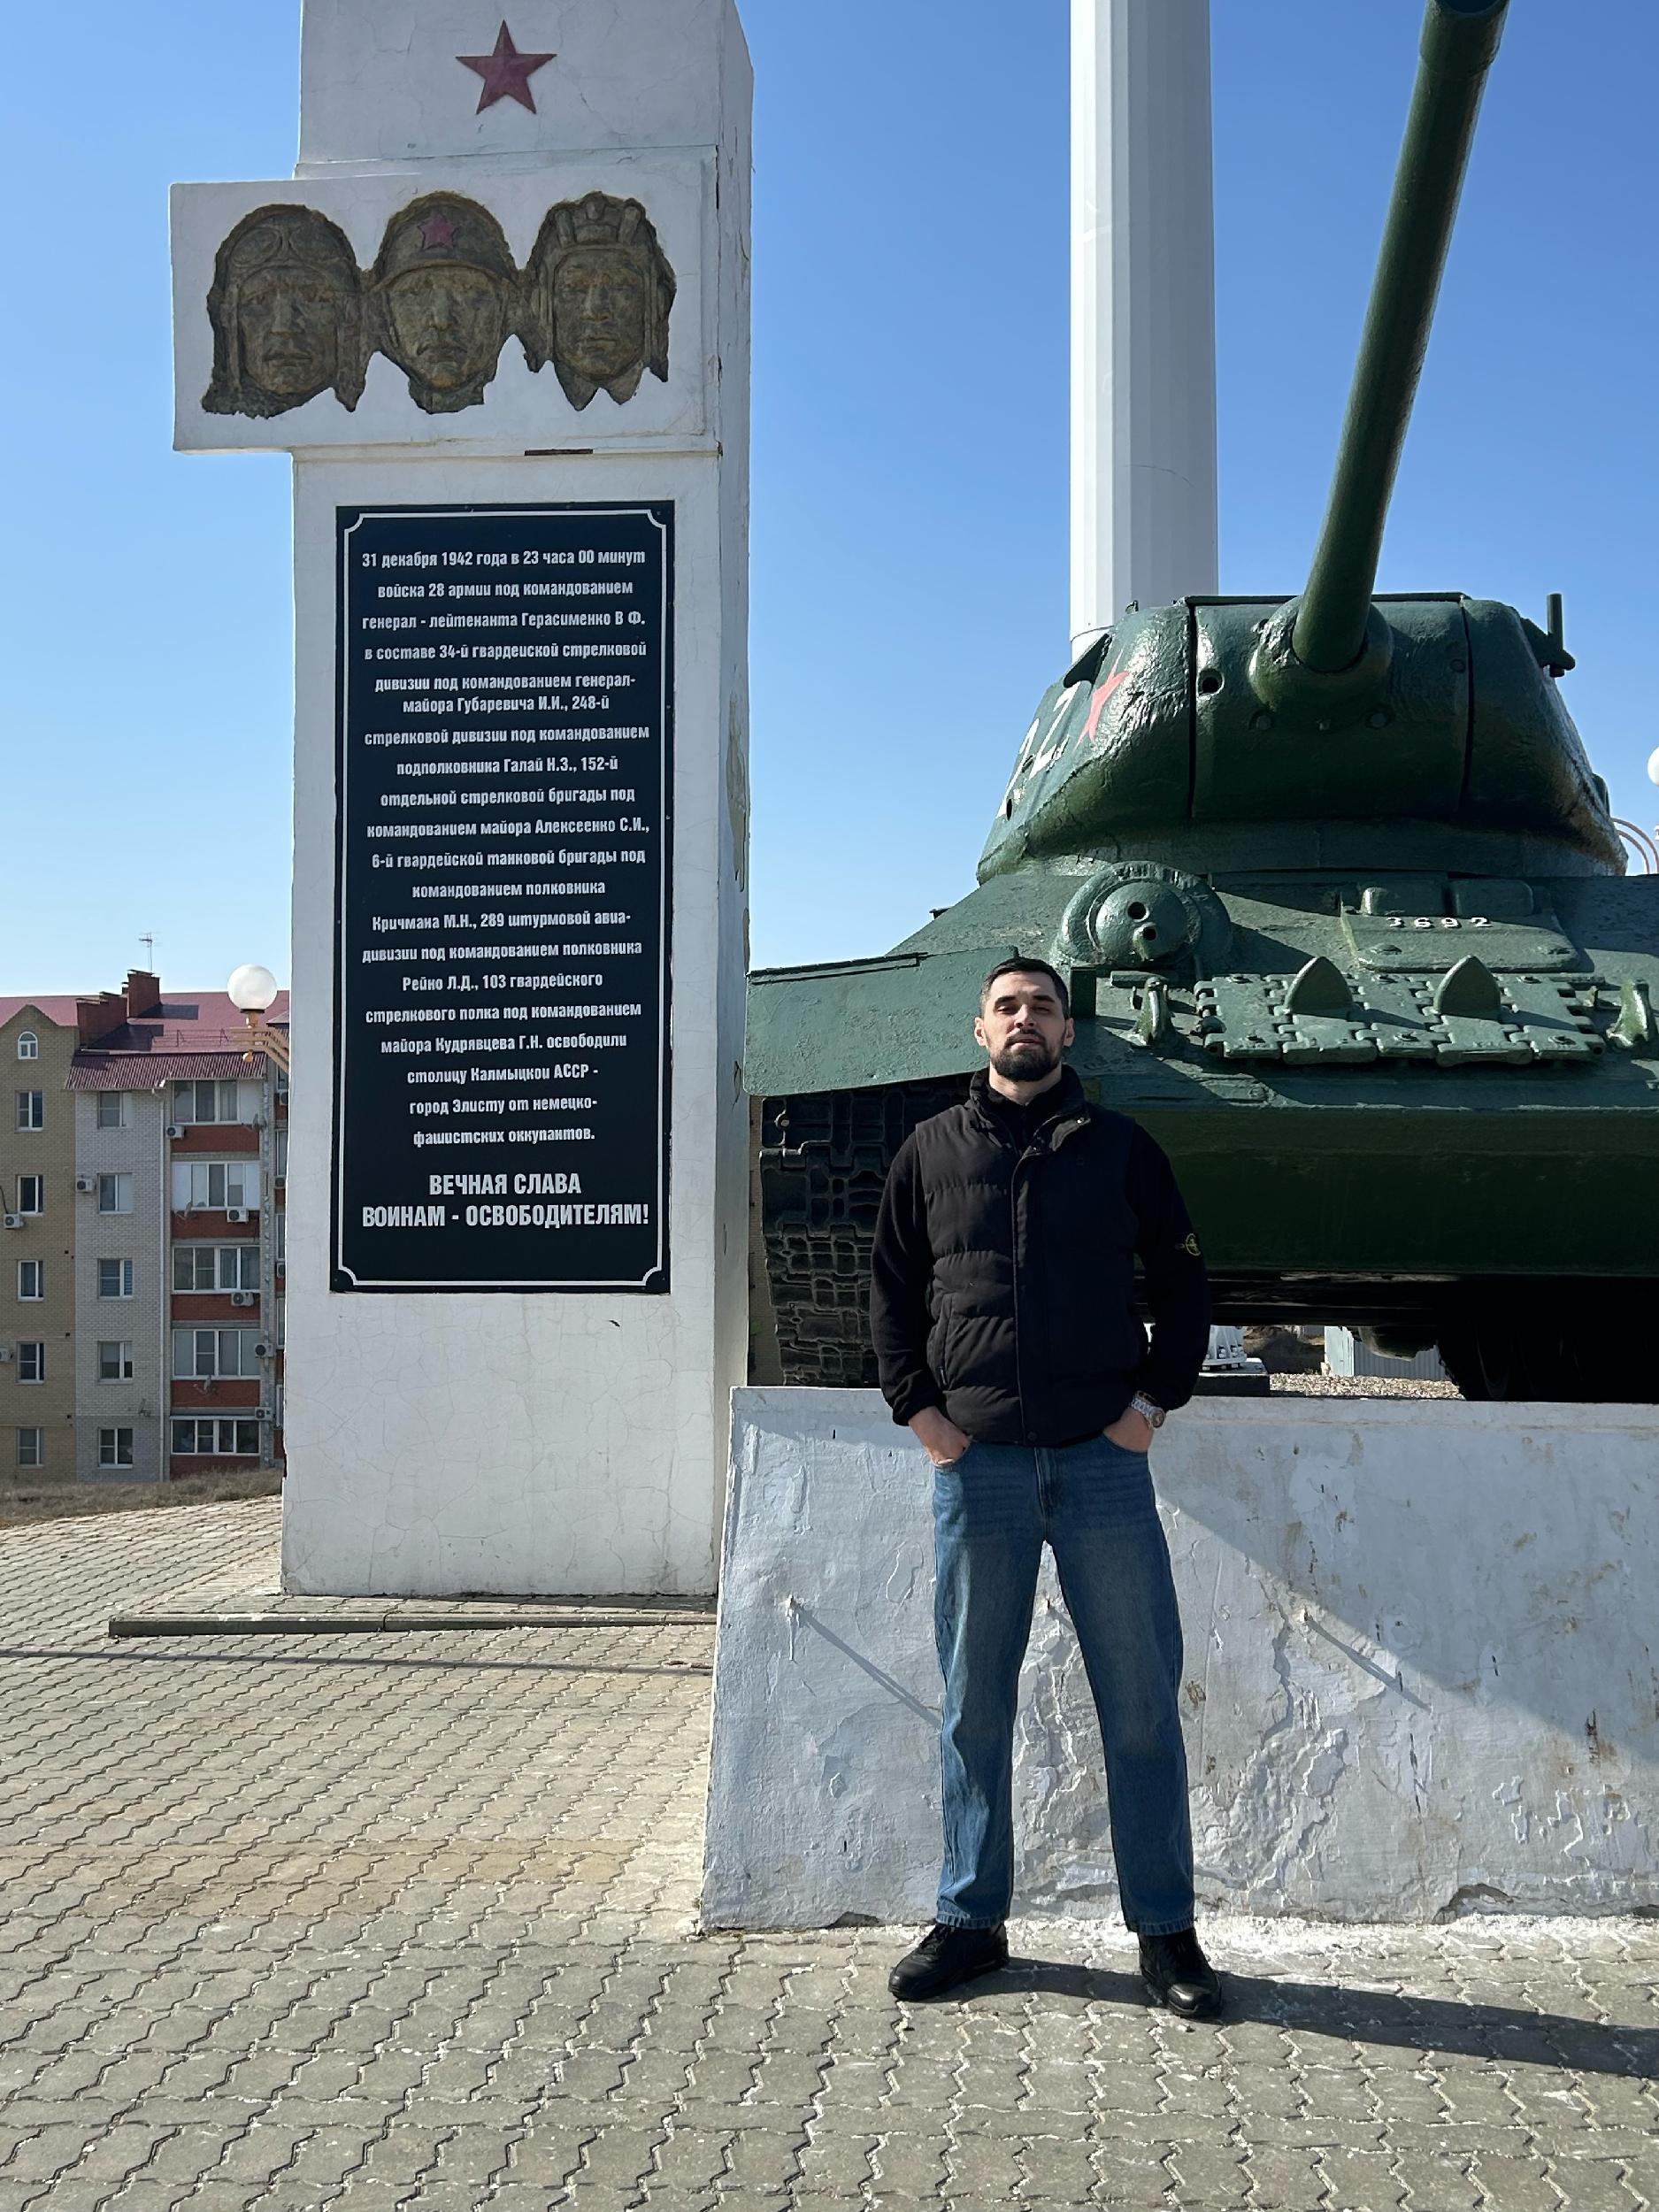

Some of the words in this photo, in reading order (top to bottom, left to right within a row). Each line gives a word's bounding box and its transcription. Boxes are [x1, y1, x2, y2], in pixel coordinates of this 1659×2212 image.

[362, 553, 377, 567] 31
[381, 551, 438, 569] декабря
[441, 551, 473, 566] 1942
[476, 553, 508, 567] года
[511, 553, 520, 565] в
[523, 550, 540, 565] 23
[542, 552, 575, 564] часа
[578, 549, 595, 564] 00
[597, 551, 646, 566] минут
[378, 583, 425, 598] войска
[428, 582, 445, 597] 28
[448, 584, 491, 599] армии
[495, 583, 520, 597] под
[523, 582, 634, 597] командованием
[362, 617, 417, 632] генерал
[428, 613, 518, 628] лейтенанта
[521, 612, 611, 629] Герасименко
[627, 611, 646, 626] Ф.
[364, 649, 373, 659] в
[376, 647, 436, 660] составе
[439, 644, 469, 658] 34-й
[562, 641, 647, 659] стрелковой
[374, 678, 430, 692] дивизии
[433, 677, 459, 691] под
[462, 676, 572, 690] командованием
[575, 674, 636, 689] генерал-
[403, 698, 454, 715] майора
[457, 696, 534, 714] Губаревича
[538, 695, 569, 711] И.И.,
[572, 695, 610, 710] 248-й
[364, 729, 449, 747] стрелковой
[451, 729, 508, 745] дивизии
[511, 729, 536, 743] под
[539, 726, 649, 742] командованием
[396, 761, 501, 776] подполковника
[503, 757, 543, 772] Галай
[546, 757, 578, 772] Н.З.,
[580, 756, 618, 772] 152-й
[380, 789, 457, 807] отдельной
[460, 788, 545, 807] стрелковой
[548, 787, 607, 804] бригады
[610, 788, 635, 802] под
[366, 823, 477, 838] командованием
[480, 819, 532, 837] майора
[534, 819, 616, 833] Алексеенко
[619, 817, 650, 833] С.И.,
[372, 853, 394, 868] 6-й
[396, 851, 484, 871] гвардейской
[487, 850, 555, 865] танковой
[558, 849, 618, 867] бригады
[620, 850, 646, 864] под
[411, 884, 523, 899] командованием
[526, 882, 606, 895] полковника
[372, 916, 441, 933] Кричмана
[443, 914, 477, 930] М.Н.,
[480, 912, 505, 927] 289
[508, 910, 591, 928] штурмовой
[594, 912, 631, 925] авиа-
[1386, 916, 1494, 929] 3692
[362, 949, 418, 964] дивизии
[420, 947, 446, 961] под
[449, 944, 559, 960] командованием
[562, 942, 642, 956] полковника
[402, 976, 443, 992] Рейно
[446, 974, 480, 991] Л.Д.,
[482, 974, 507, 989] 103
[510, 972, 603, 991] гвардейского
[365, 1009, 457, 1025] стрелкового
[459, 1007, 500, 1020] полка
[503, 1006, 528, 1021] под
[531, 1003, 641, 1018] командованием
[380, 1039, 432, 1055] майора
[434, 1038, 516, 1054] Кудрявцева
[518, 1034, 543, 1049] Г.Н.
[546, 1033, 627, 1048] освободили
[407, 1070, 468, 1085] столицу
[553, 1063, 589, 1079] АССР
[409, 1102, 449, 1117] город
[452, 1099, 505, 1114] Элисту
[508, 1100, 530, 1112] от
[533, 1097, 598, 1111] немецко-
[413, 1131, 505, 1148] фашистских
[508, 1127, 595, 1144] оккупантов.
[429, 1173, 508, 1195] ВЕЧНАЯ
[513, 1173, 582, 1194] СЛАВА
[362, 1206, 446, 1227] ВОИНАМ
[465, 1203, 649, 1229] ОСВОБОДИТЕЛЯМ!
